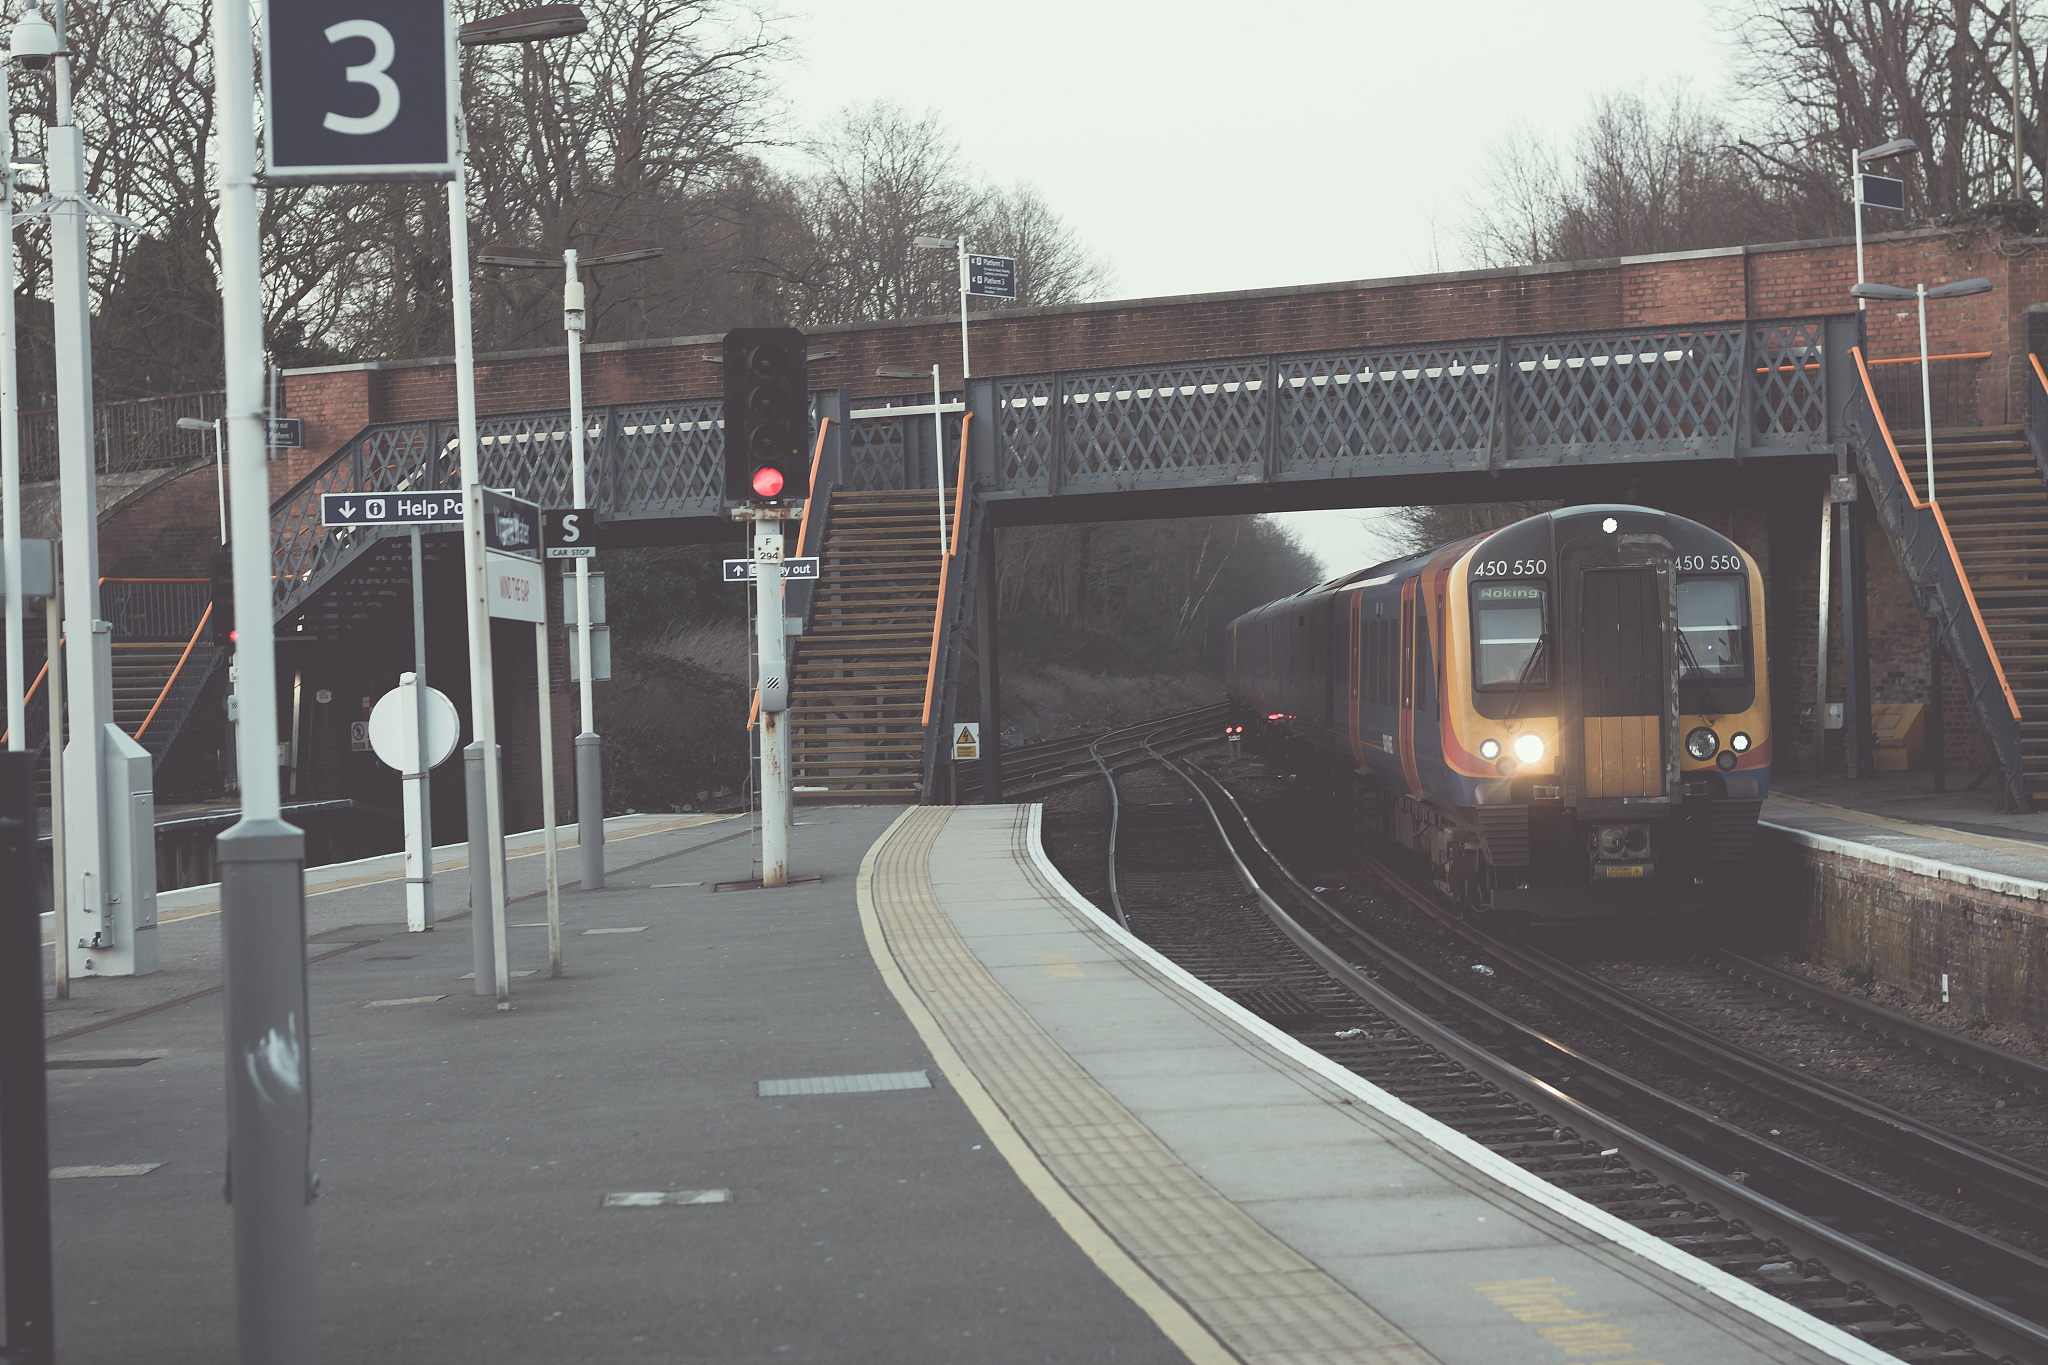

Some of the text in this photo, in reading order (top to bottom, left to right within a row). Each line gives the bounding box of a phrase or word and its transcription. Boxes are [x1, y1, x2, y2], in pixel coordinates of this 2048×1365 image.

[323, 19, 400, 134] 3
[983, 258, 1001, 266] Platform
[984, 276, 1006, 286] Platform 3
[397, 499, 439, 519] Help
[562, 514, 580, 543] S
[765, 537, 772, 546] F
[760, 552, 779, 560] 294
[1674, 555, 1741, 571] 450 550
[779, 563, 812, 577] ay out
[1474, 559, 1547, 576] 450 550
[1481, 588, 1538, 598] Woking
[1537, 1323, 1638, 1356] the
